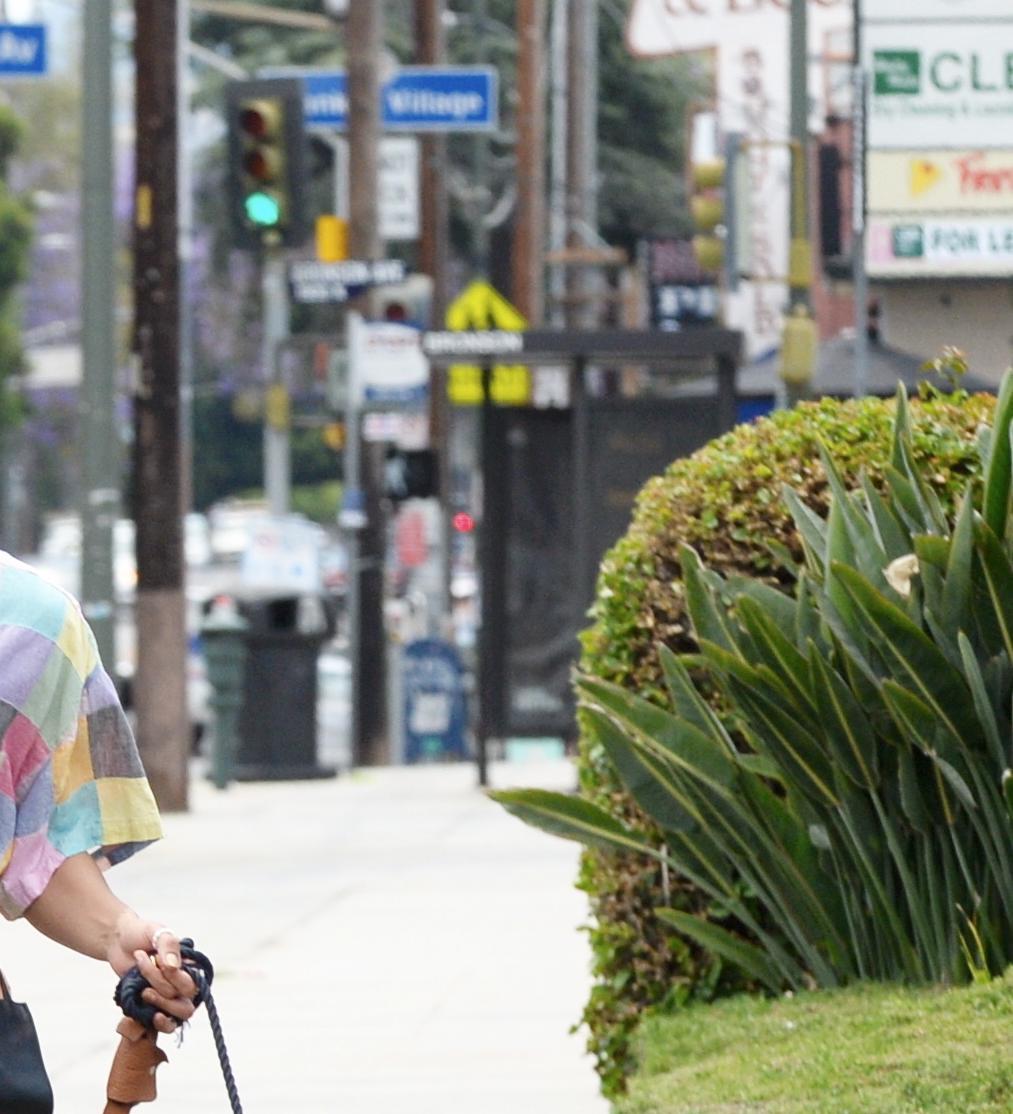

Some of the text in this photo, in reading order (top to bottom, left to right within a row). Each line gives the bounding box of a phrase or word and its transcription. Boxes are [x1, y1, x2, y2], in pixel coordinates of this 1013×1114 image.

[388, 90, 484, 118] Village
[930, 228, 979, 252] FOR
[423, 330, 523, 354] BRONSON
